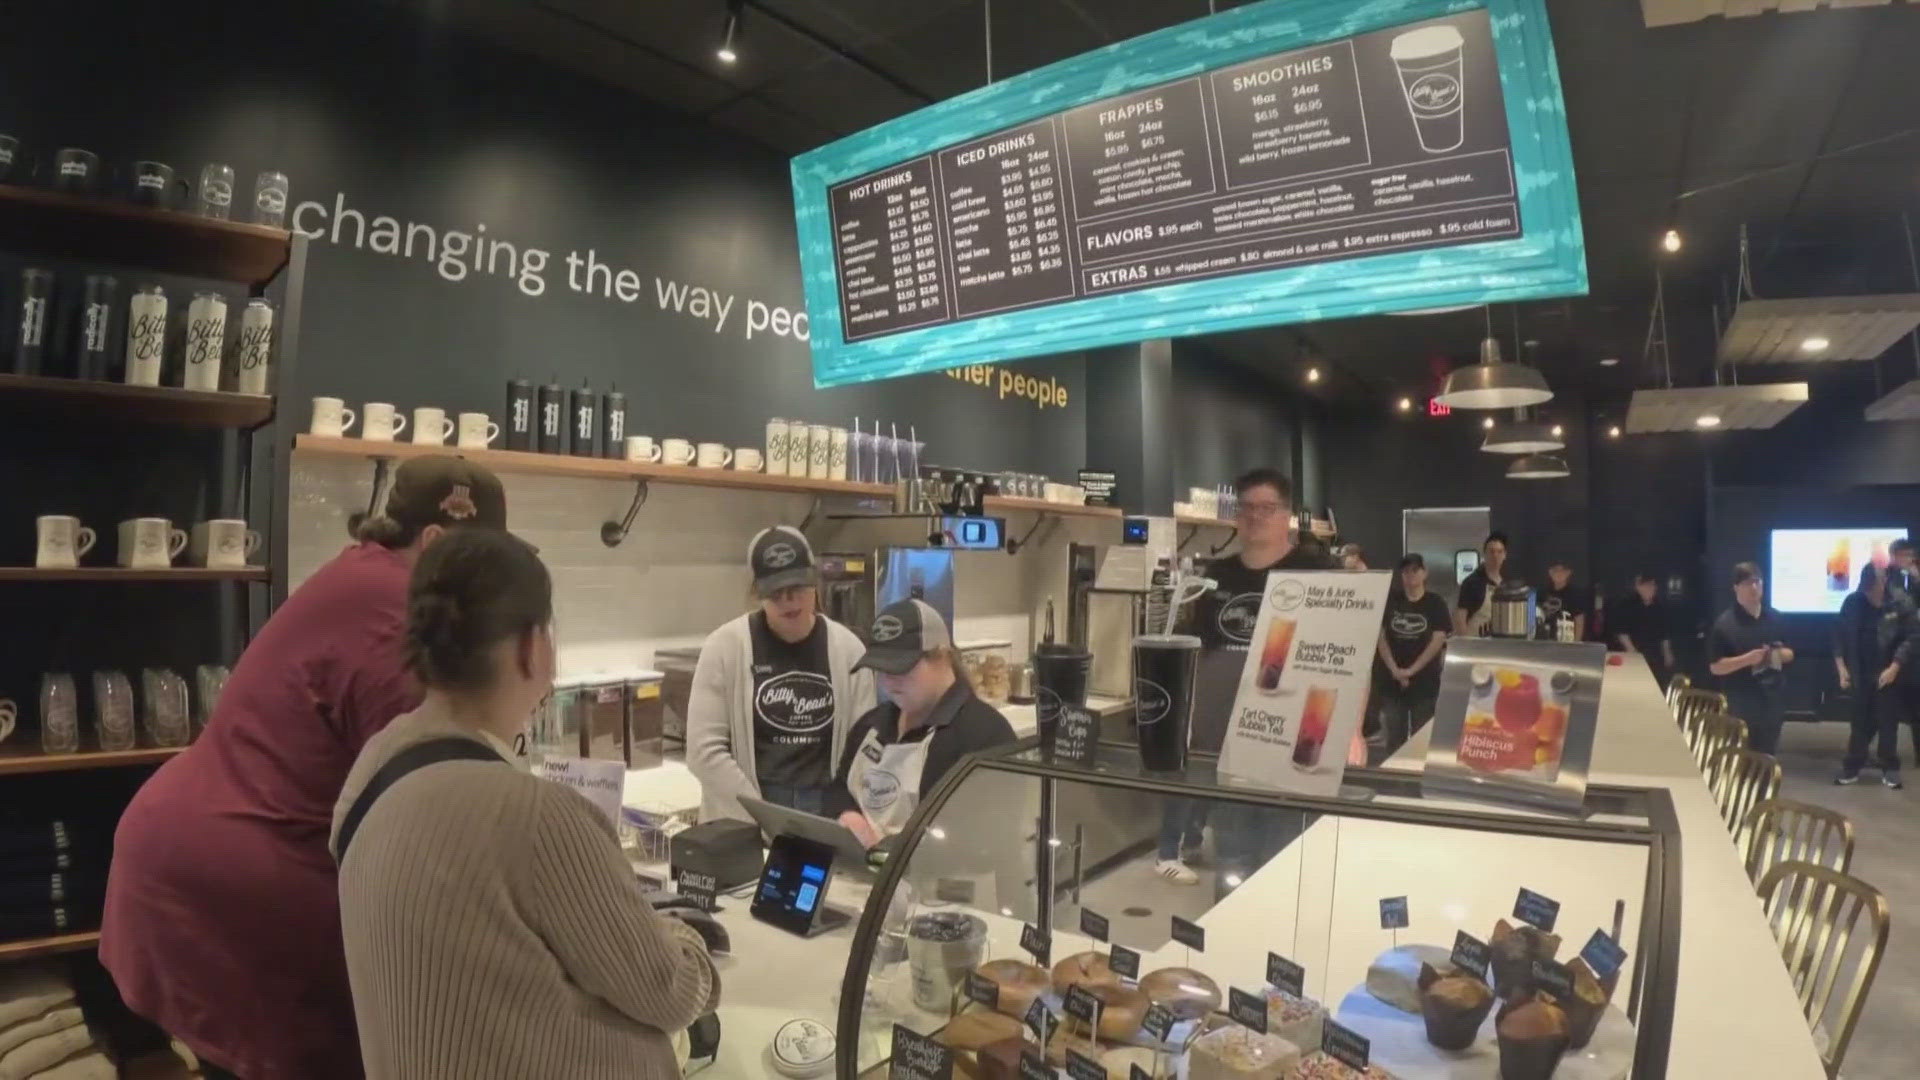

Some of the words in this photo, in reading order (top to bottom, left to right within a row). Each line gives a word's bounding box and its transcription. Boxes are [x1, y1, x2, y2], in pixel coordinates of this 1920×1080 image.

[1233, 56, 1333, 92] SMOOTHIES
[1252, 94, 1276, 106] 16oz
[1292, 84, 1319, 98] 24oz
[1099, 98, 1164, 126] FRAPPES
[1105, 131, 1125, 142] 16oz
[1139, 121, 1163, 133] 24oz
[957, 149, 985, 166] ICED
[989, 134, 1035, 158] DRINKS
[1027, 150, 1049, 162] 24oz
[1239, 153, 1254, 164] wild
[1281, 144, 1307, 156] frozen
[1309, 136, 1351, 150] lemonade
[849, 184, 870, 201] HOT
[873, 171, 912, 194] DRINKS
[950, 186, 972, 199] coffee
[1100, 186, 1115, 194] mint
[1118, 189, 1140, 200] frozen
[1141, 187, 1153, 195] hot
[1155, 179, 1192, 193] chocolate
[951, 200, 966, 211] cold
[968, 196, 986, 208] brew
[953, 208, 990, 224] americano
[954, 224, 979, 236] mocha
[1087, 225, 1153, 250] FLAVORS
[1180, 220, 1202, 233] each
[955, 238, 972, 248] latte
[957, 252, 972, 261] chai
[974, 247, 990, 256] latte
[1092, 265, 1147, 287] EXTRAS
[1175, 260, 1209, 273] whipped
[1211, 256, 1236, 267] cream
[1263, 246, 1294, 259] almond
[1366, 233, 1389, 244] extra
[1391, 228, 1432, 241] espresso
[1440, 223, 1460, 234] $.95
[1463, 220, 1484, 231] cold
[1486, 218, 1510, 229] foam
[292, 192, 549, 296] changing
[566, 249, 641, 302] the
[655, 278, 734, 333] way
[746, 299, 810, 341] peo
[959, 266, 971, 274] tea
[960, 274, 987, 287] matcha
[988, 270, 1005, 281] latte
[946, 364, 995, 387] her
[1000, 369, 1068, 409] people
[1430, 398, 1451, 415] EXIT
[1307, 586, 1325, 597] May
[1327, 587, 1333, 596] &
[1335, 587, 1355, 598] June
[1305, 598, 1344, 610] Specialty
[1346, 599, 1374, 610] Drinks
[1299, 640, 1326, 651] Sweet
[1327, 643, 1356, 656] Peach
[1295, 649, 1326, 663] Bubble
[1328, 653, 1344, 665] Tea
[1243, 707, 1258, 719] Tart
[1258, 710, 1287, 725] Cherry
[1239, 717, 1266, 732] Bubble
[1269, 725, 1284, 736] Tea
[1464, 735, 1513, 752] Hibiscus
[1461, 745, 1497, 760] Punch
